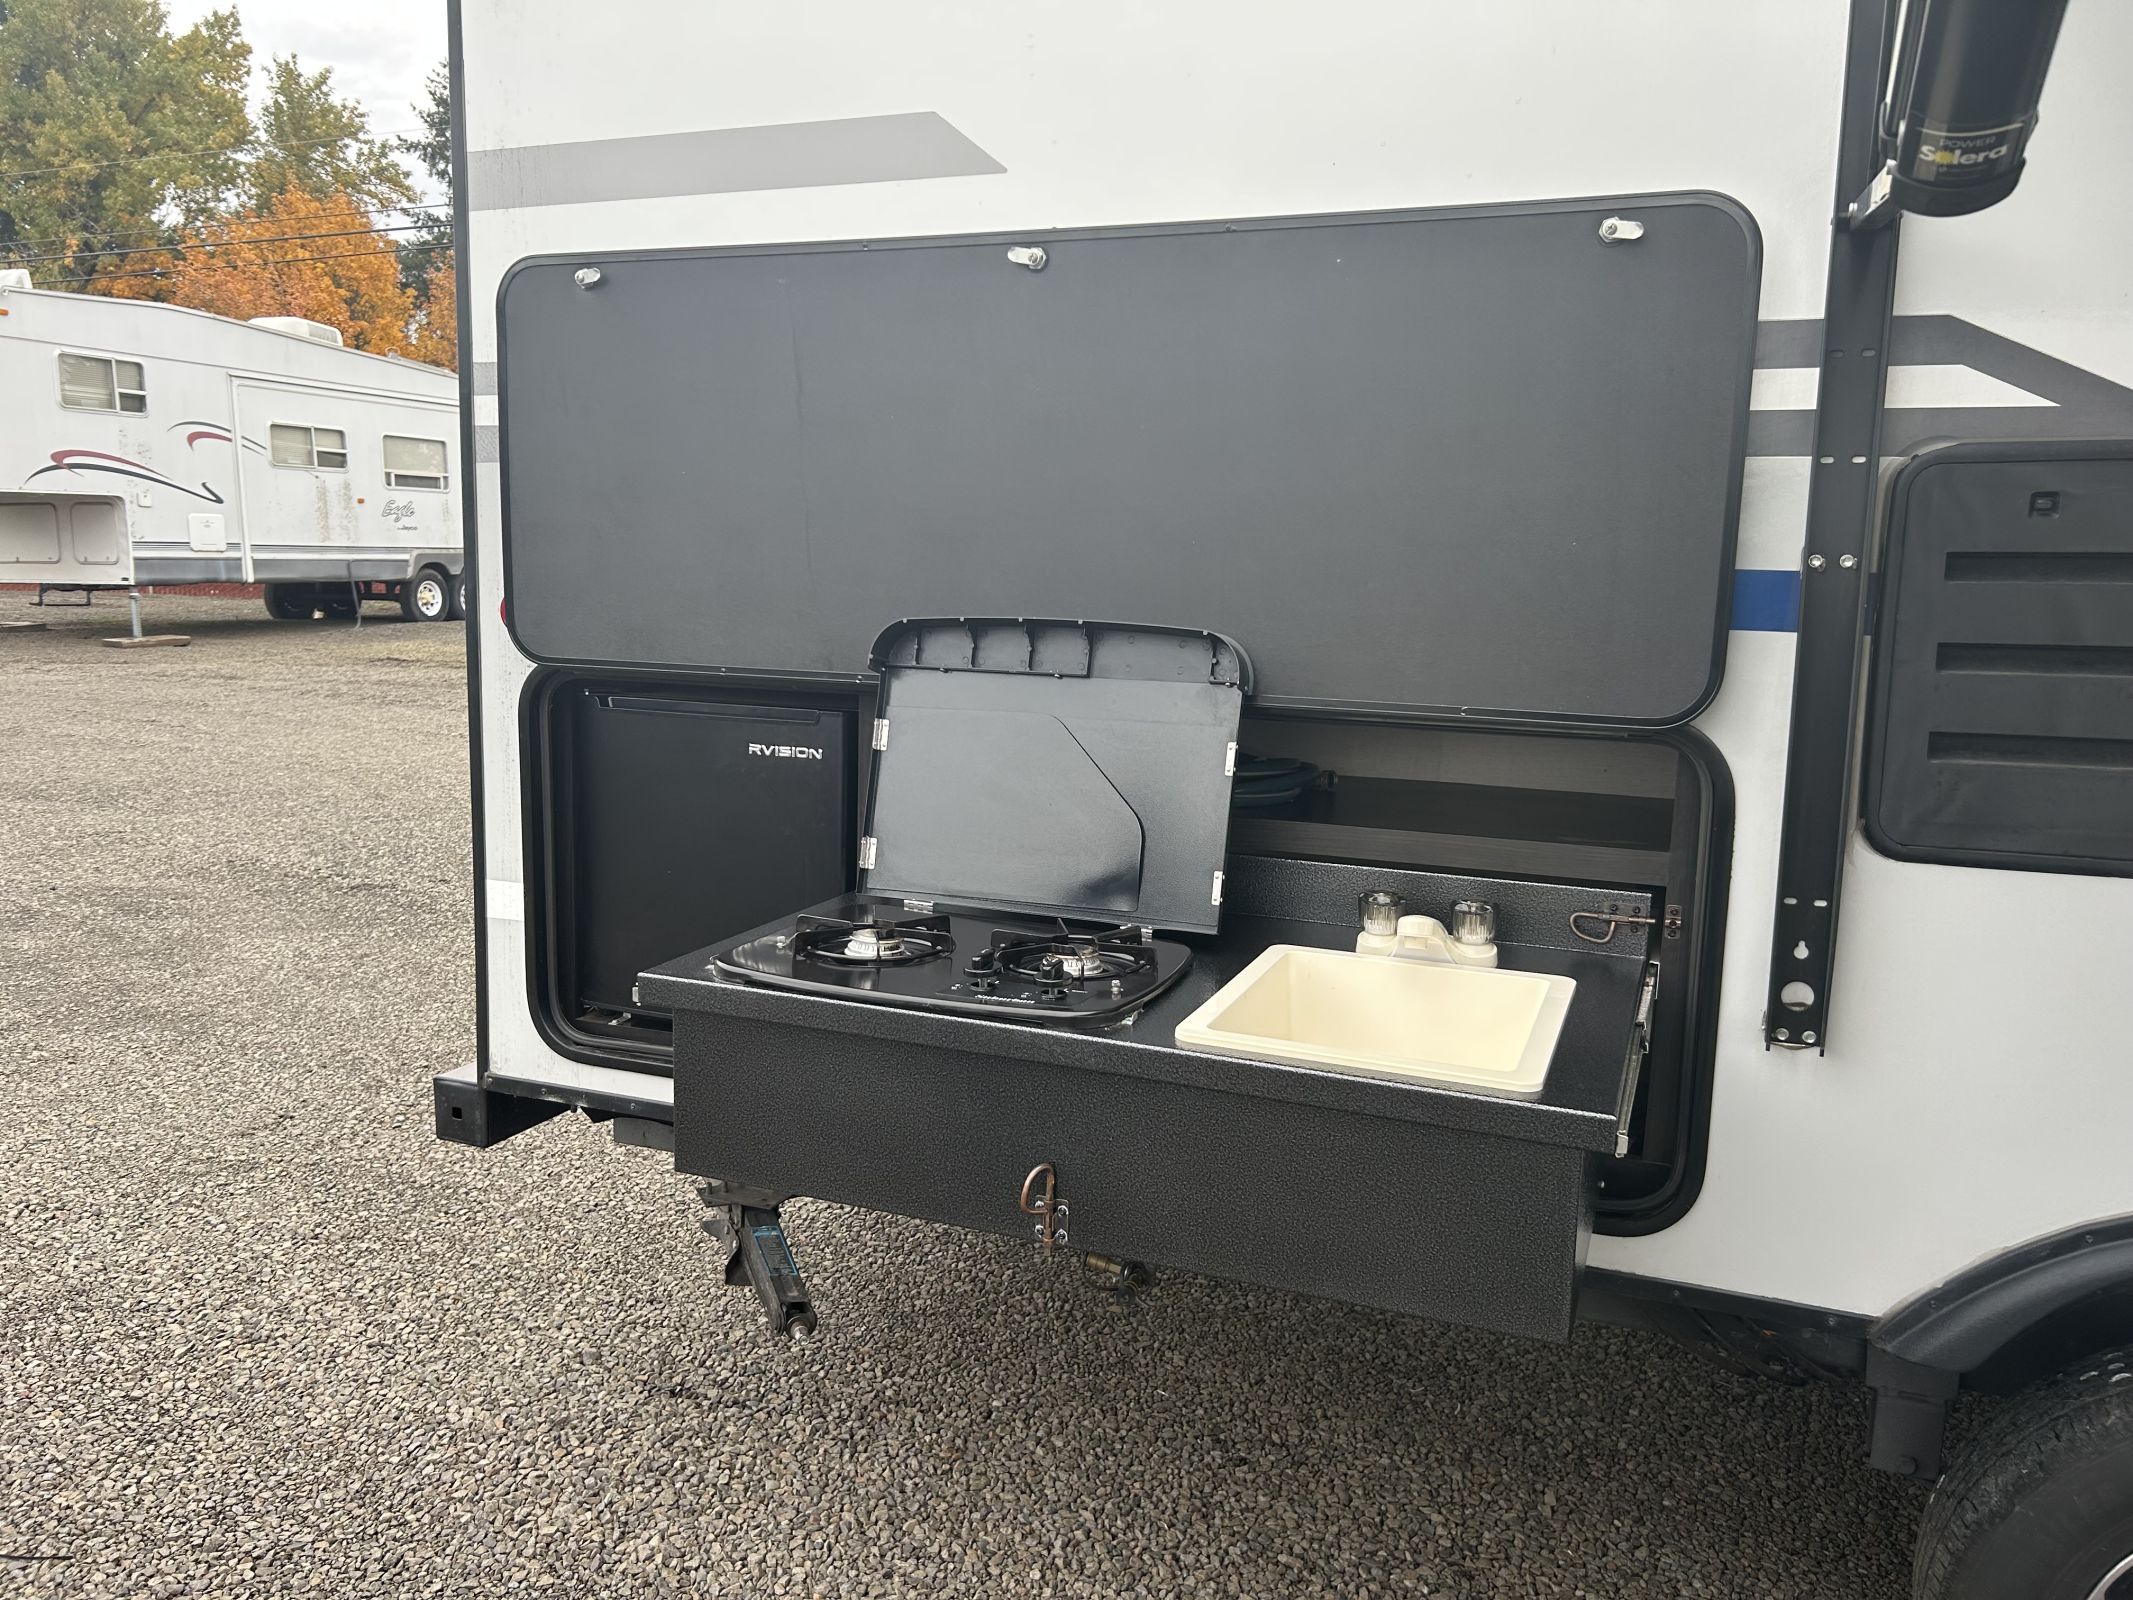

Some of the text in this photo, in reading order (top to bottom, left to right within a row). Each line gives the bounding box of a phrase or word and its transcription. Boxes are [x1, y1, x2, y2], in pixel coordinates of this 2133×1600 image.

[1940, 135, 1996, 149] POWER
[1919, 144, 2008, 165] Solera
[382, 499, 416, 523] Eagle
[748, 742, 823, 760] RVISION
